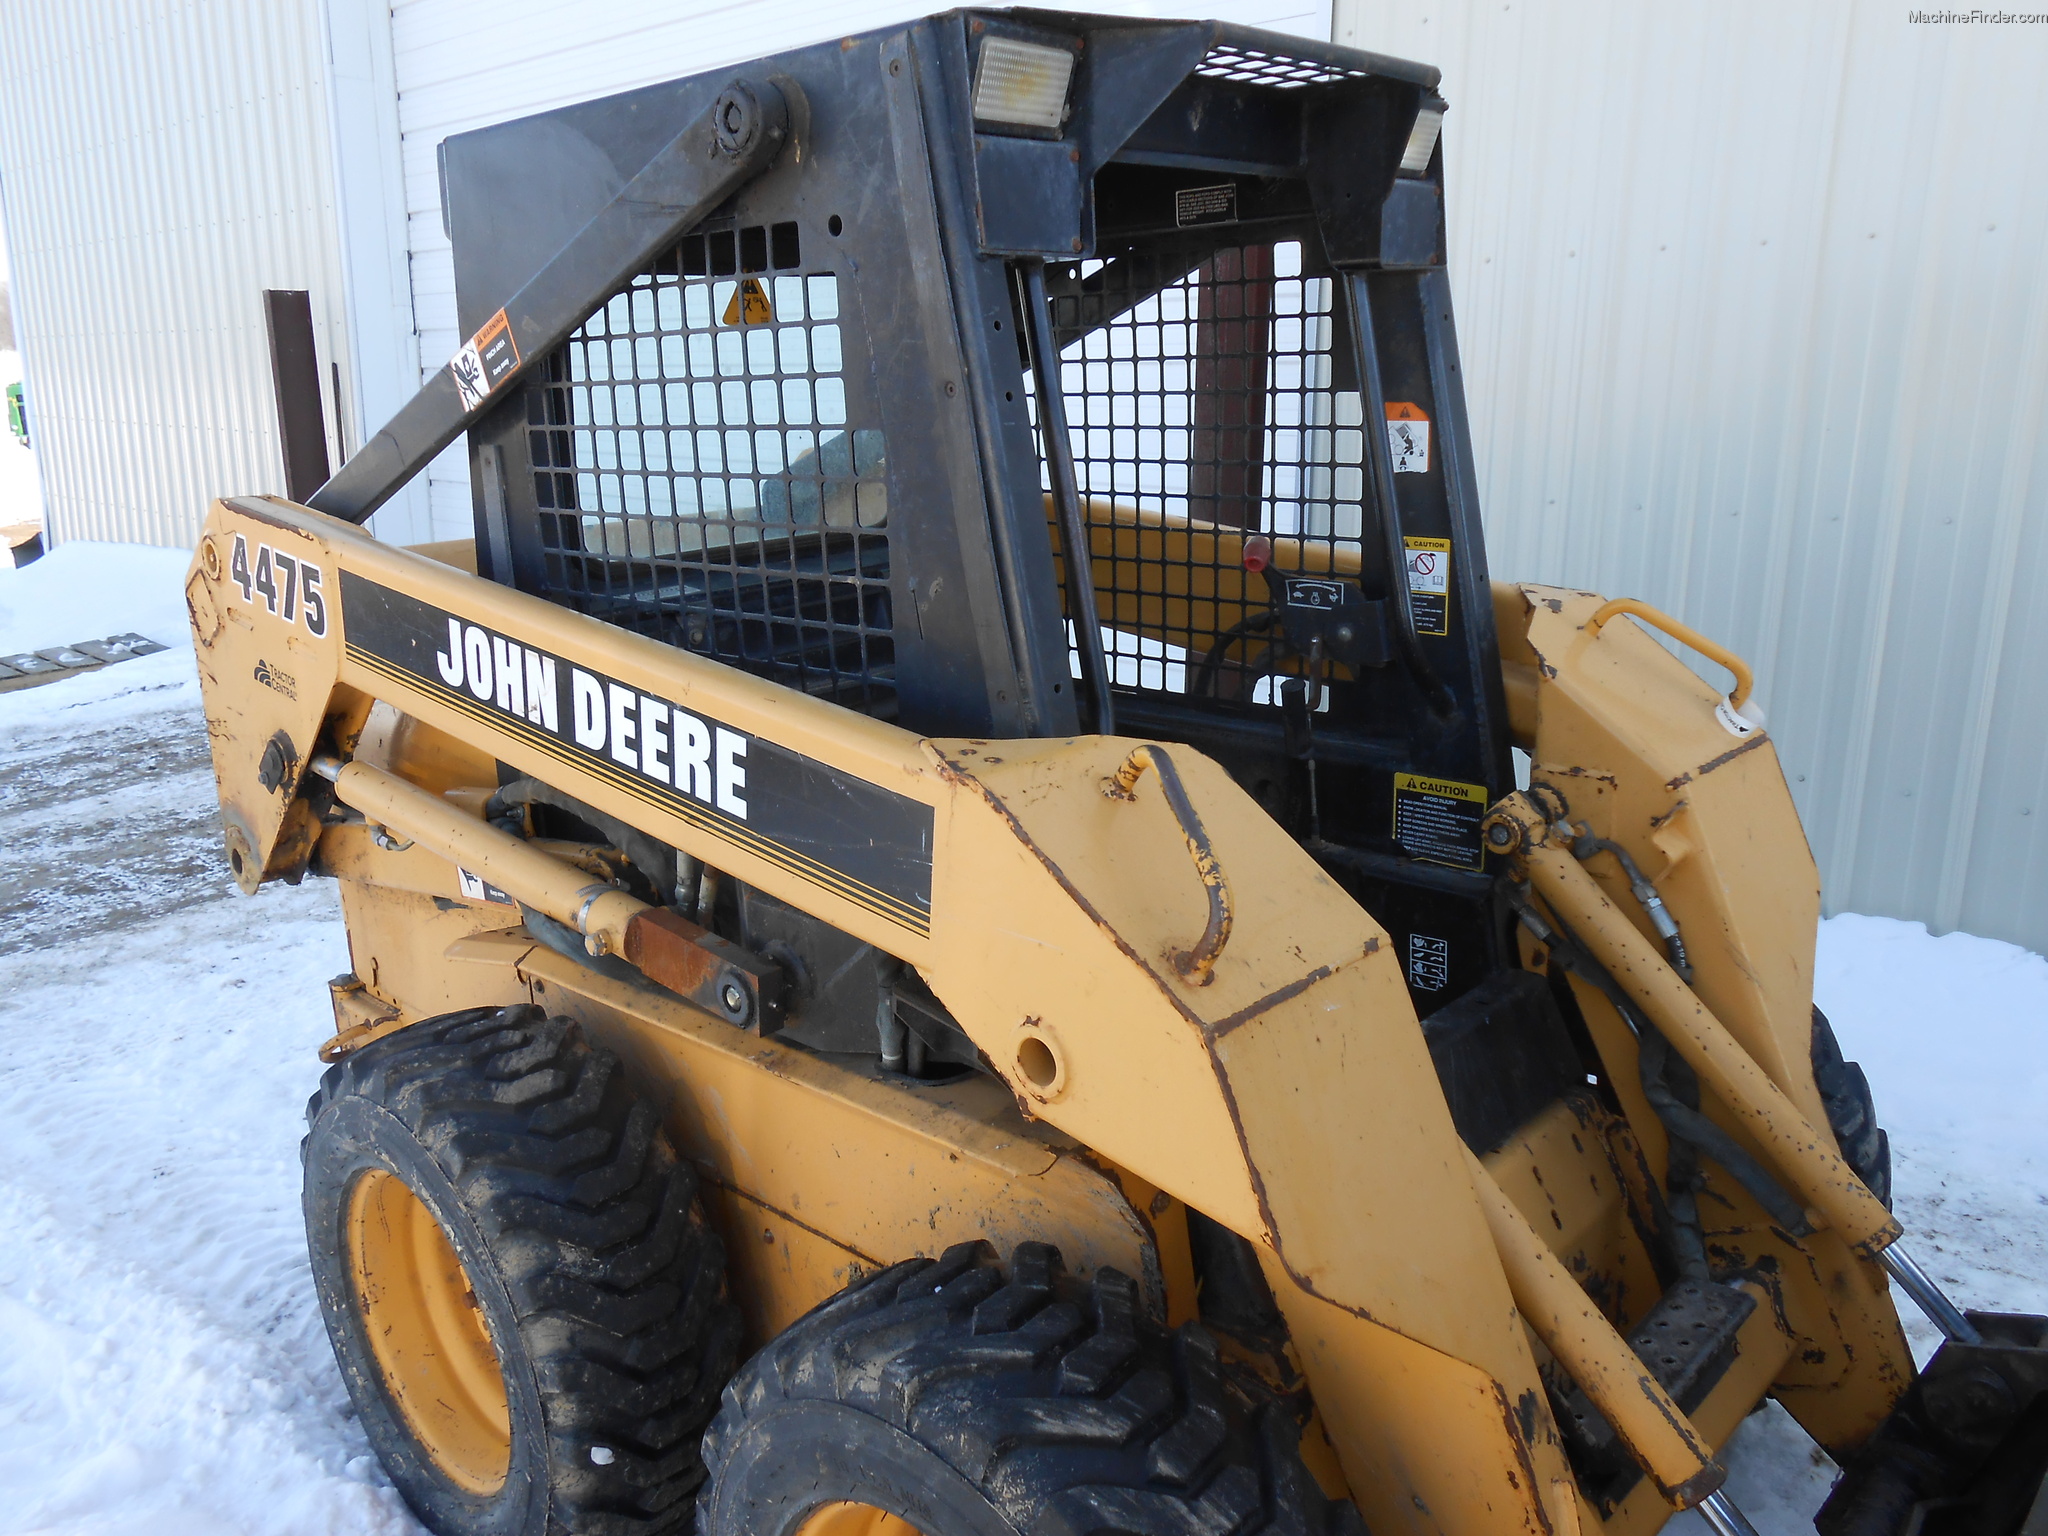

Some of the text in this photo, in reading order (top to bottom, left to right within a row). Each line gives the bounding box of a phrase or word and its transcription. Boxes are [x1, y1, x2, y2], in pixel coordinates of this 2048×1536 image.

[1414, 540, 1445, 548] CAUTION
[231, 532, 328, 639] 4475
[270, 663, 296, 688] TRACTOR
[272, 677, 297, 702] CENTRAL
[436, 617, 747, 820] JOHN DEERE
[1420, 782, 1468, 797] CAUTION
